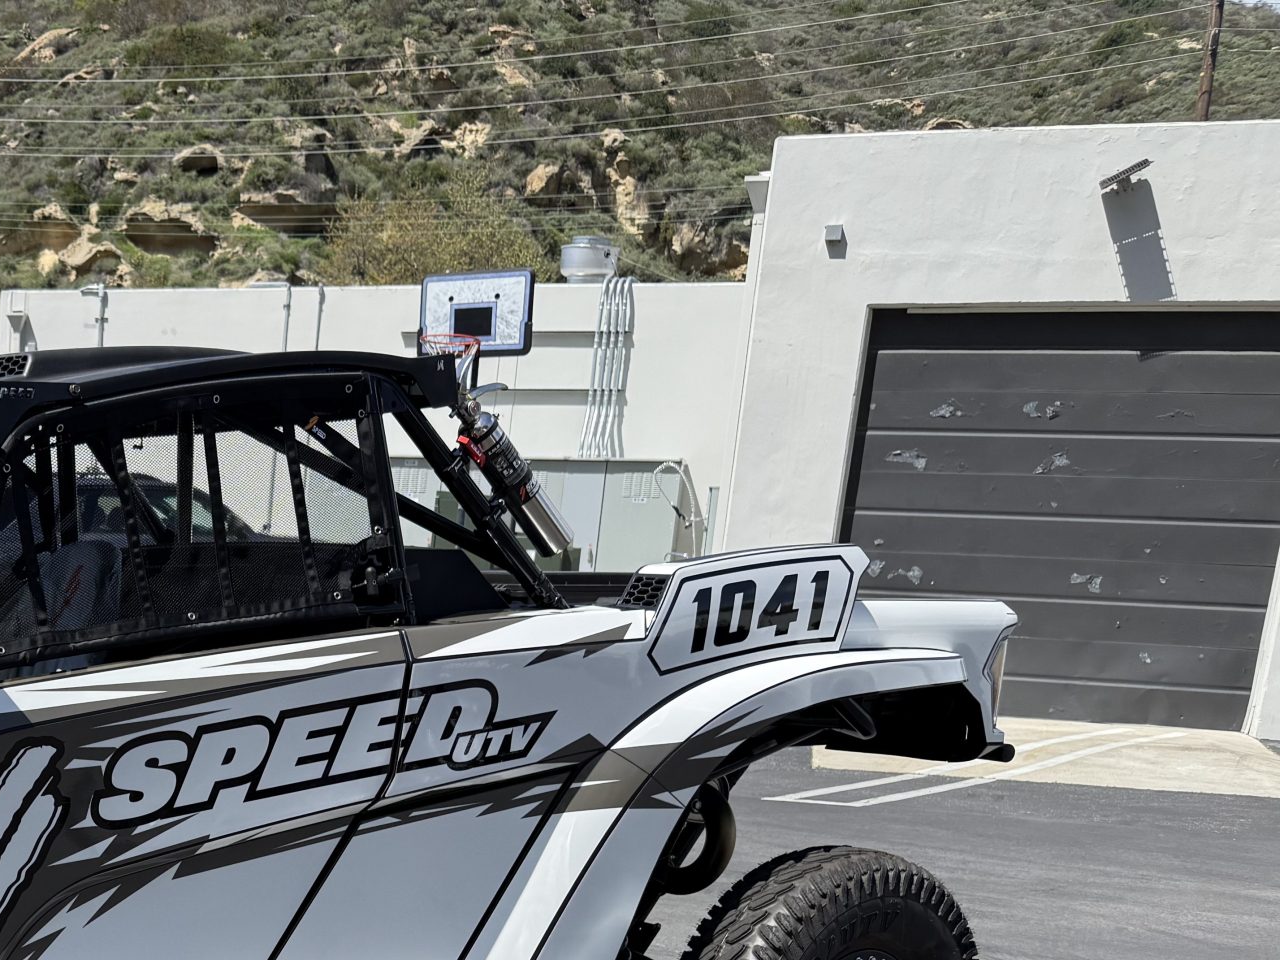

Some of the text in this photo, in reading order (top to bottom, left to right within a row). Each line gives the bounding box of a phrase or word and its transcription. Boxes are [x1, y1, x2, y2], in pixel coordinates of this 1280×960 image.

[690, 570, 831, 653] 1041
[95, 683, 548, 826] SPEED UTV
